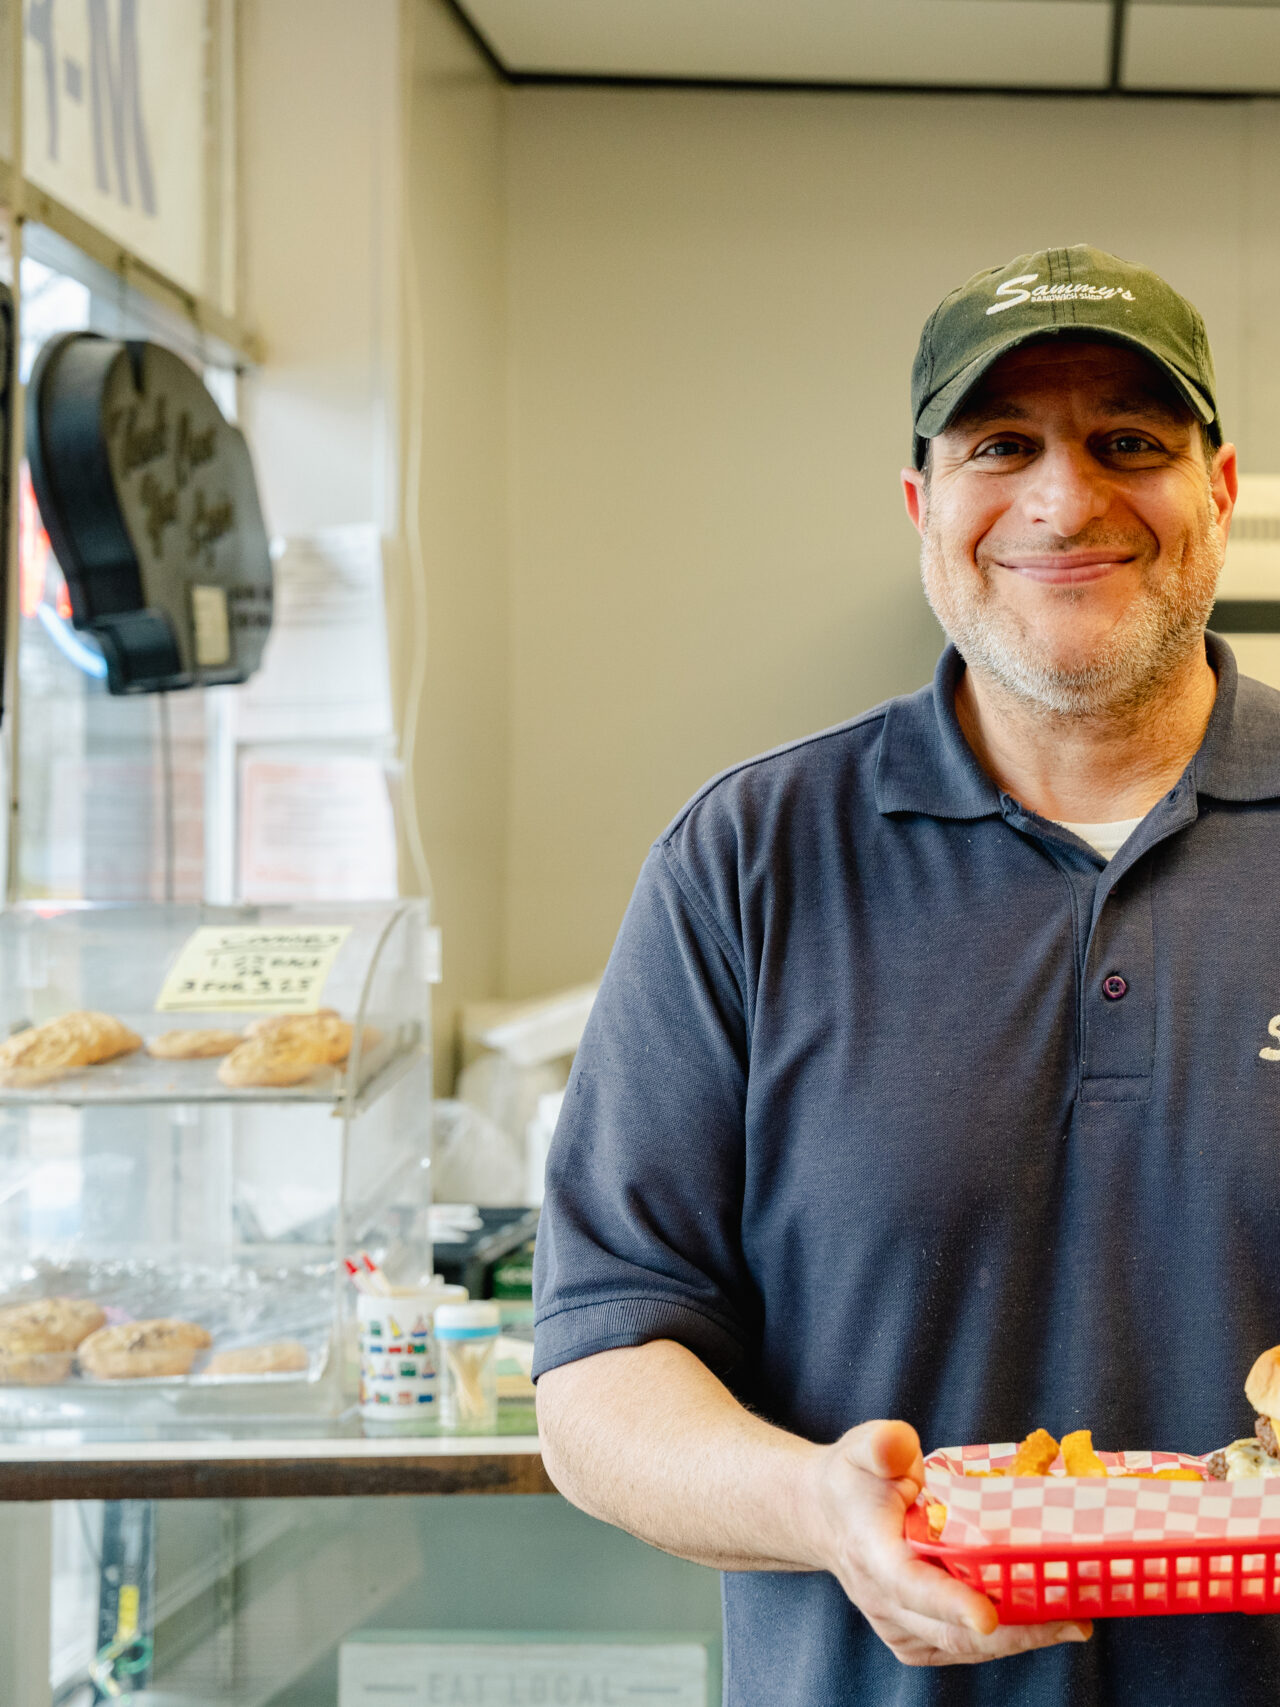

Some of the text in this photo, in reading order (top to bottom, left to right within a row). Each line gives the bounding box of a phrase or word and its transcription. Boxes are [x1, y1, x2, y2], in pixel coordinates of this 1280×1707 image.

[986, 273, 1136, 315] Sammy's
[1031, 292, 1103, 302] SANDWICH SHOP
[427, 1672, 619, 1705] EAT LOCAL
